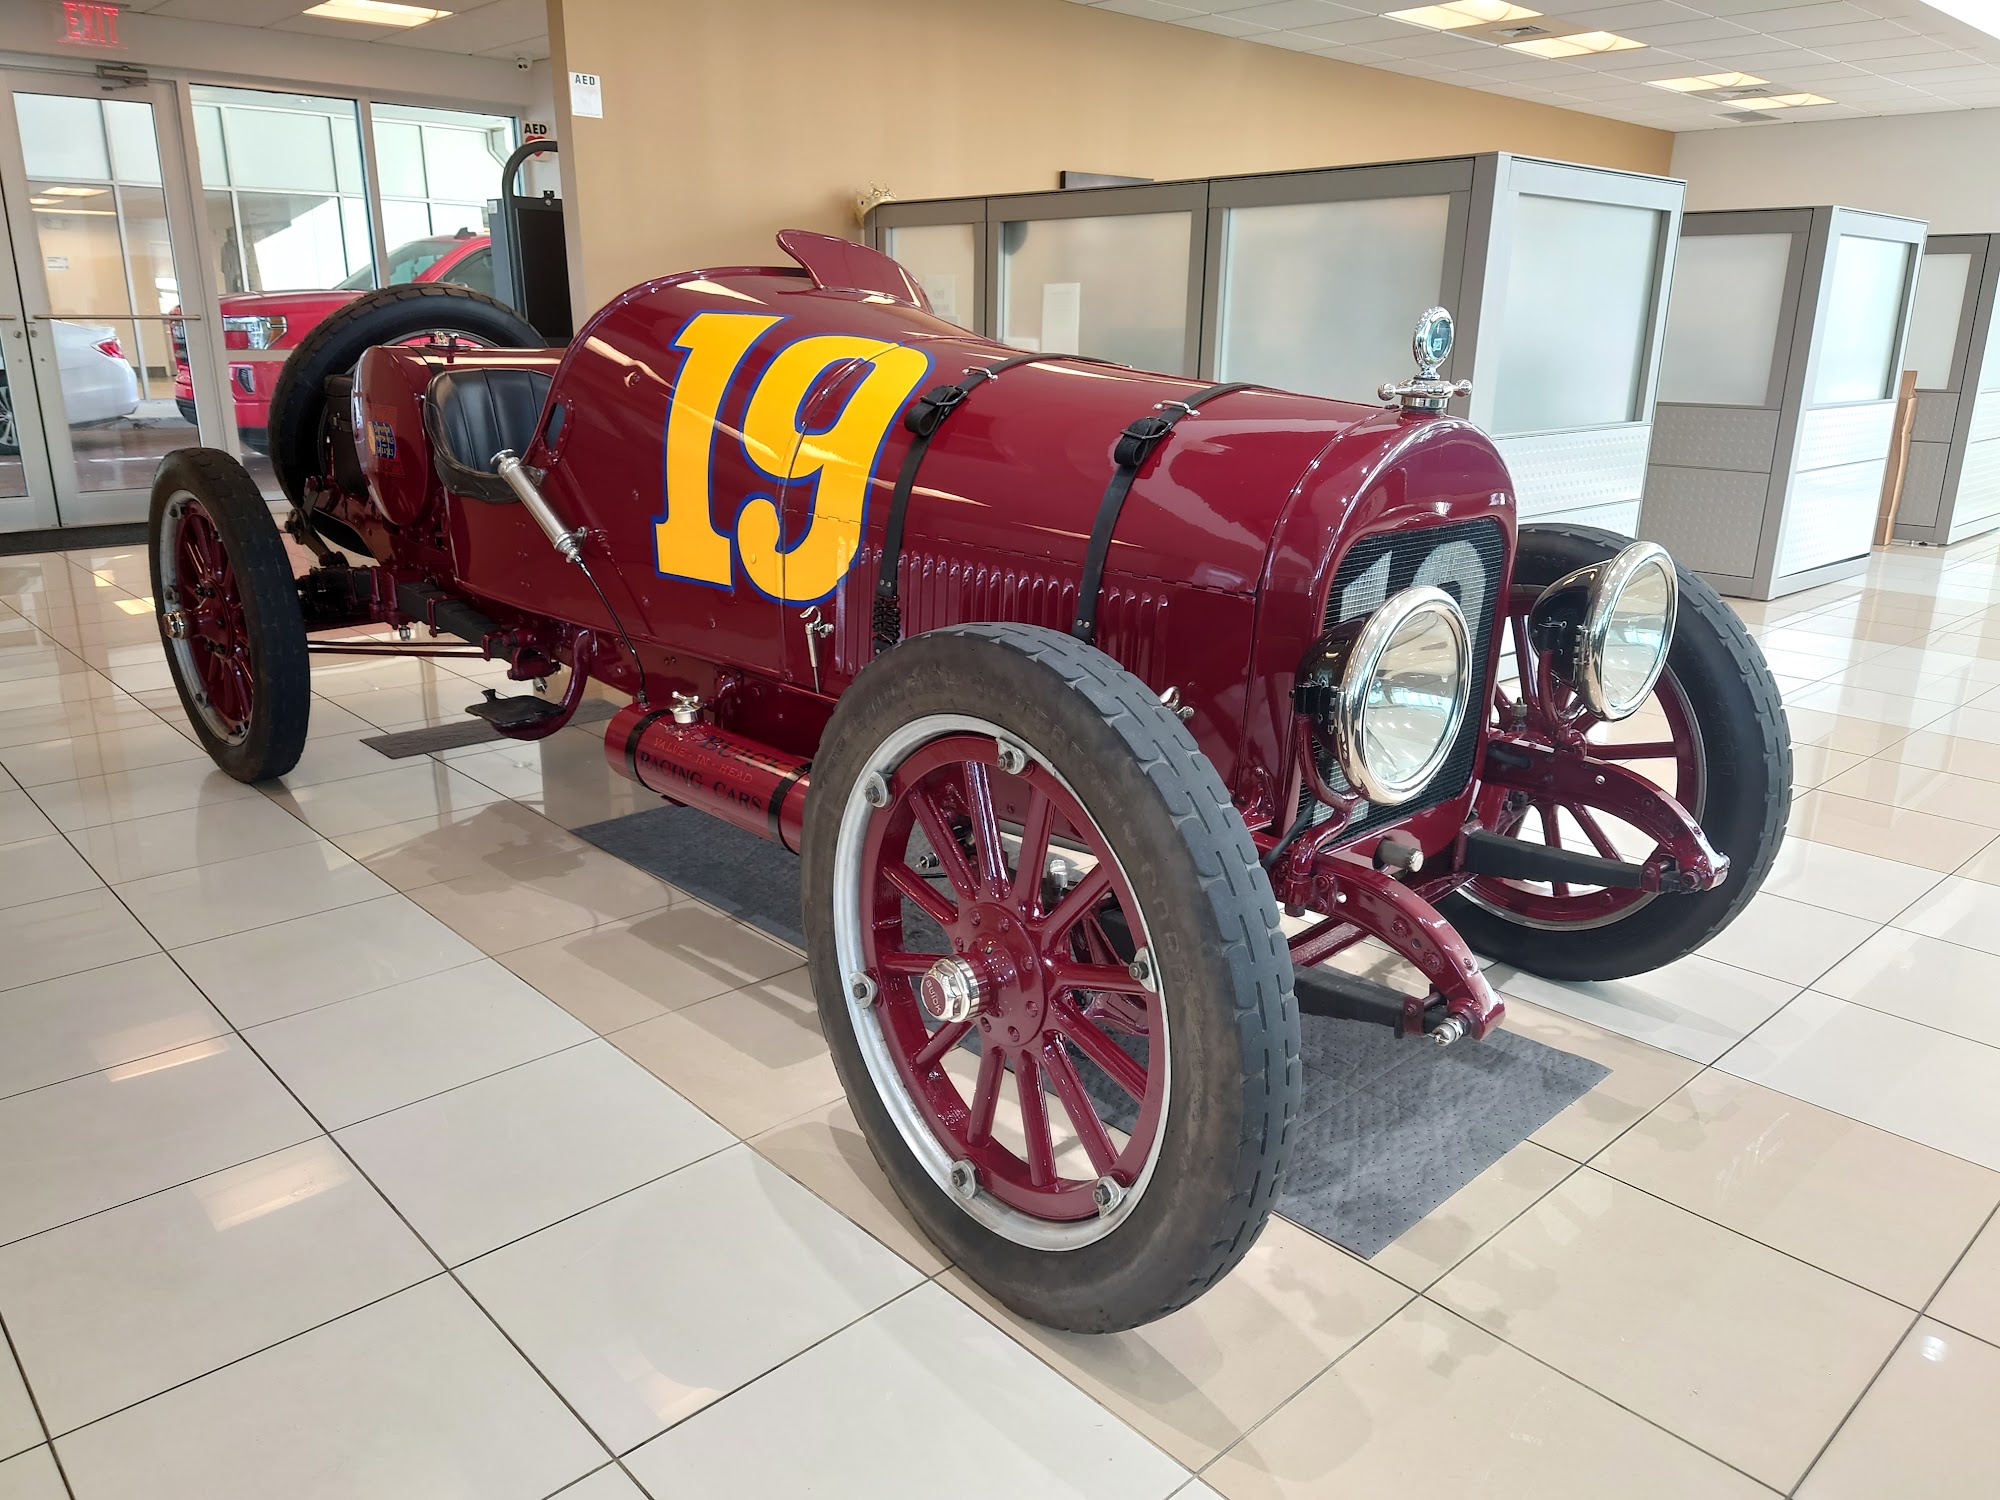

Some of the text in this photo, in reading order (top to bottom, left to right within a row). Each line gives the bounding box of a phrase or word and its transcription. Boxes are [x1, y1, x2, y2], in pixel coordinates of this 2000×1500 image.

[63, 2, 118, 43] EXIT
[575, 74, 595, 86] AED
[524, 123, 547, 134] AED
[651, 309, 935, 606] 19
[653, 737, 687, 757] VALVE
[695, 754, 710, 766] IN
[719, 764, 753, 783] HEAD
[639, 751, 762, 813] RACING CARS
[925, 979, 942, 1014] BUICK
